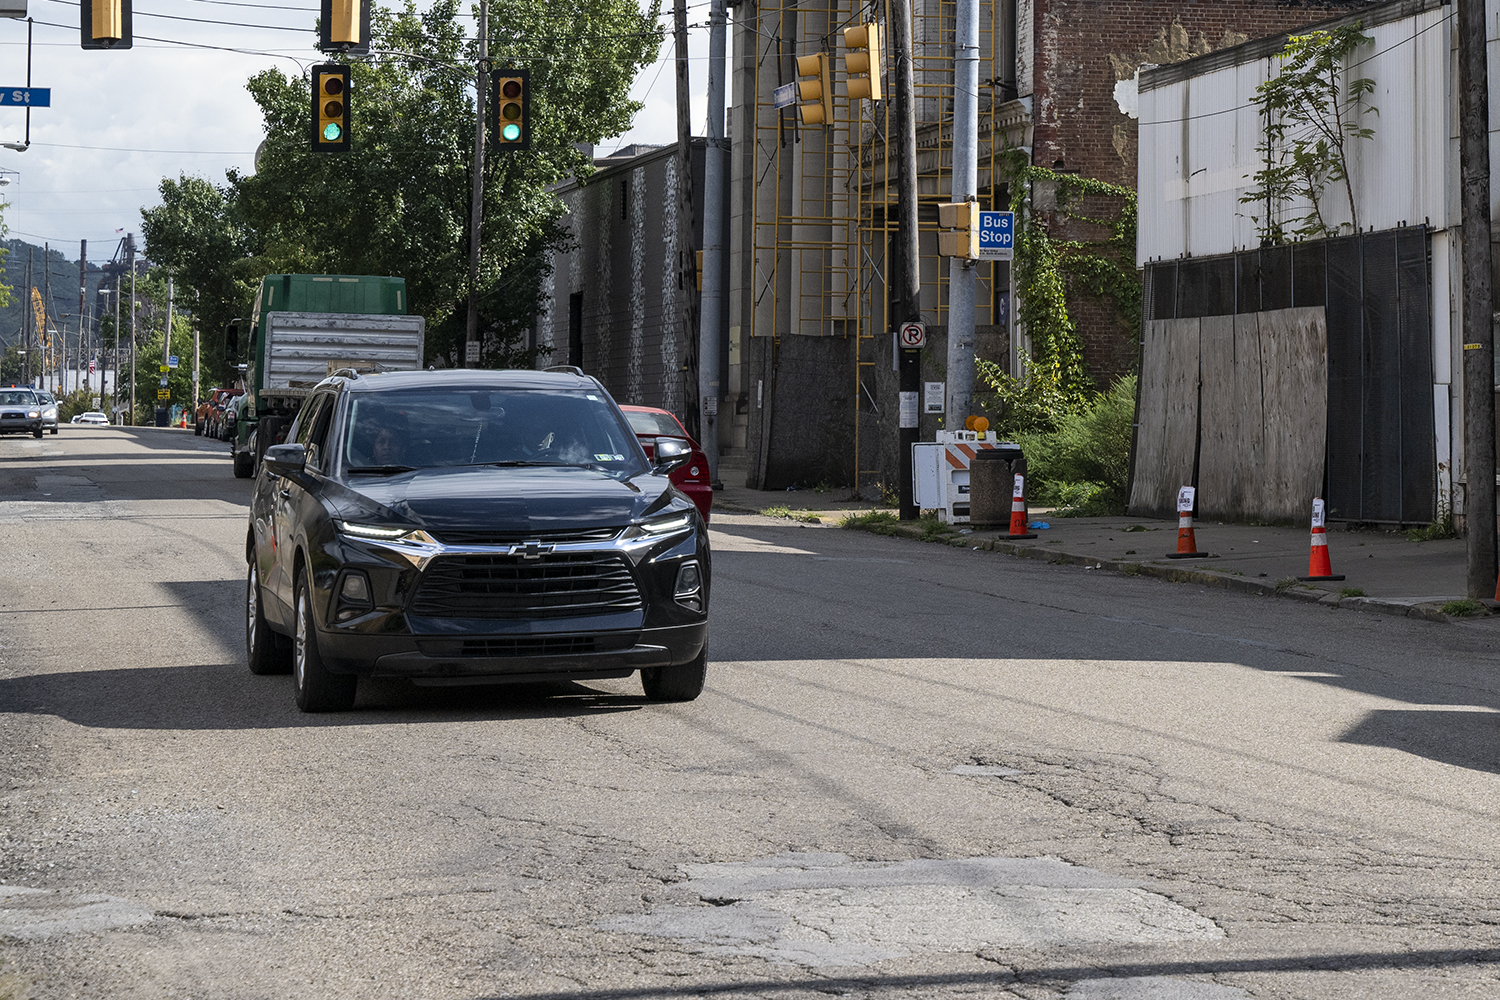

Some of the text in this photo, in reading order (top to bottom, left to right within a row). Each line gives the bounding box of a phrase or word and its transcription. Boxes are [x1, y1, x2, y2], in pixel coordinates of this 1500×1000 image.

[12, 90, 30, 103] St
[983, 215, 1009, 228] Bus
[980, 230, 1011, 245] Stop
